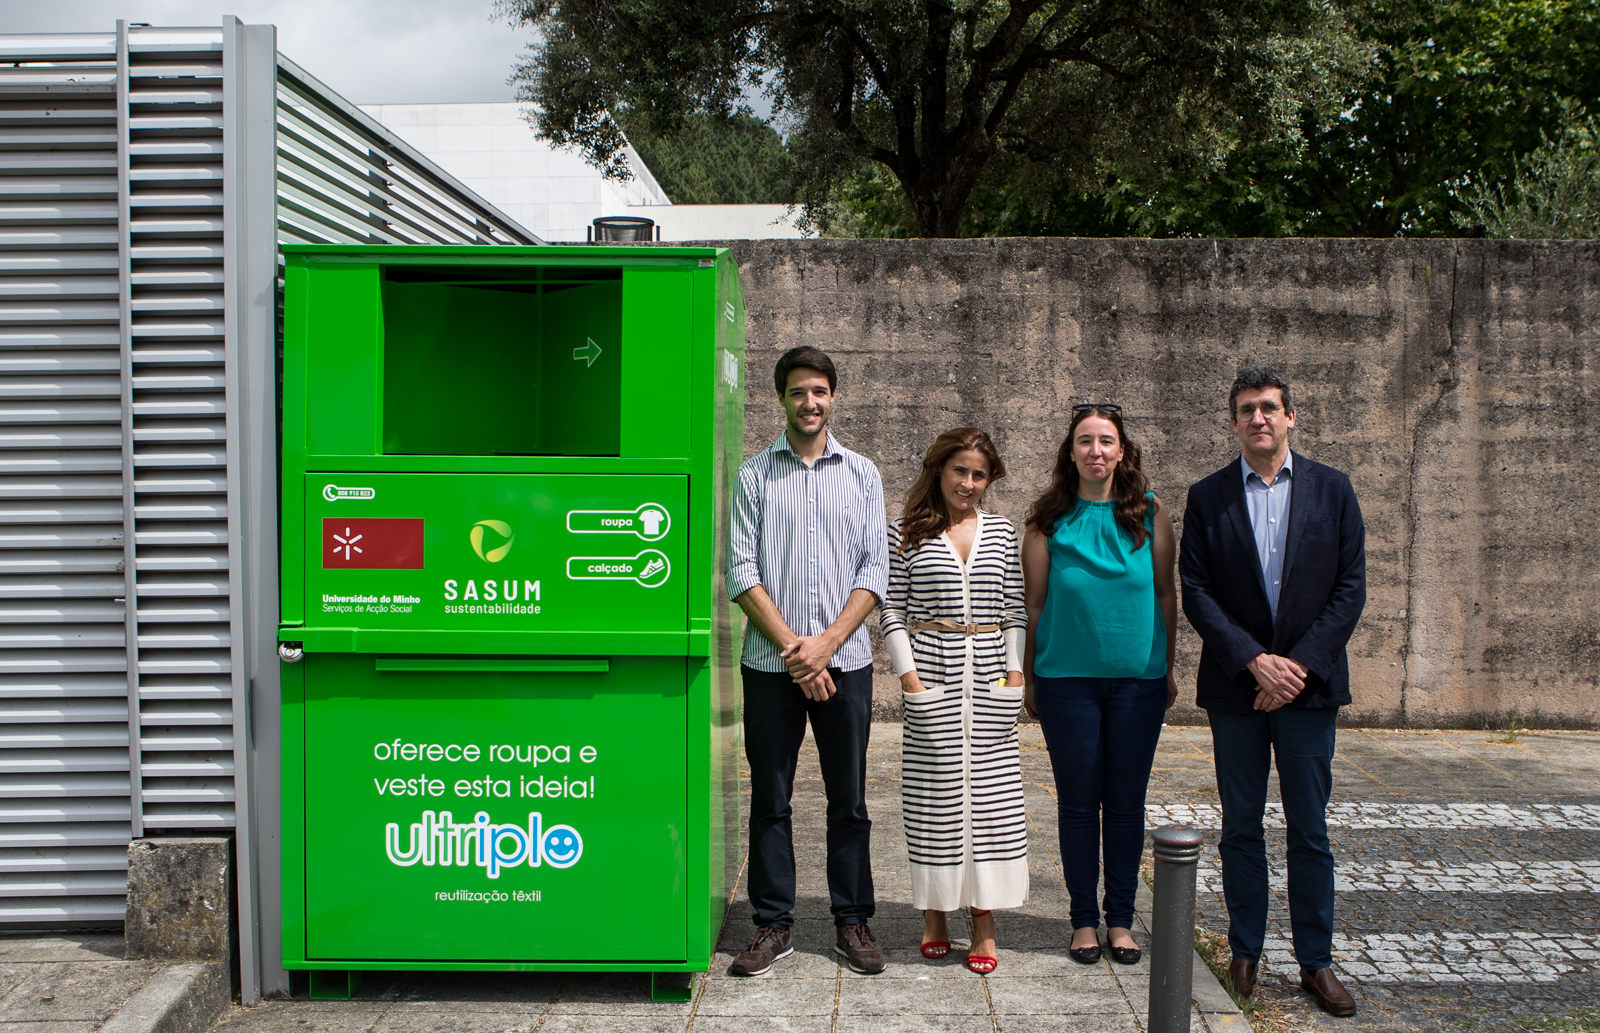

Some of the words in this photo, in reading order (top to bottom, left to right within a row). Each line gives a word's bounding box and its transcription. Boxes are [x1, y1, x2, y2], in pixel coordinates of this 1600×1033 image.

[601, 518, 633, 528] roupa
[587, 563, 633, 574] calçado
[444, 579, 541, 601] SASUM
[322, 594, 378, 603] Universidade
[380, 595, 391, 603] do
[393, 595, 421, 604] Minho
[322, 604, 353, 614] Serviços
[355, 604, 364, 612] de
[366, 604, 388, 614] Acção
[390, 604, 412, 613] Social
[444, 603, 541, 614] sustentabilidade
[374, 738, 481, 761] oferece
[489, 744, 570, 768] roupa
[579, 745, 597, 763] e
[374, 774, 445, 797] veste
[454, 775, 511, 798] esta
[520, 776, 594, 798] ideia!
[435, 890, 509, 904] reutilização
[512, 890, 542, 902] têxtil
